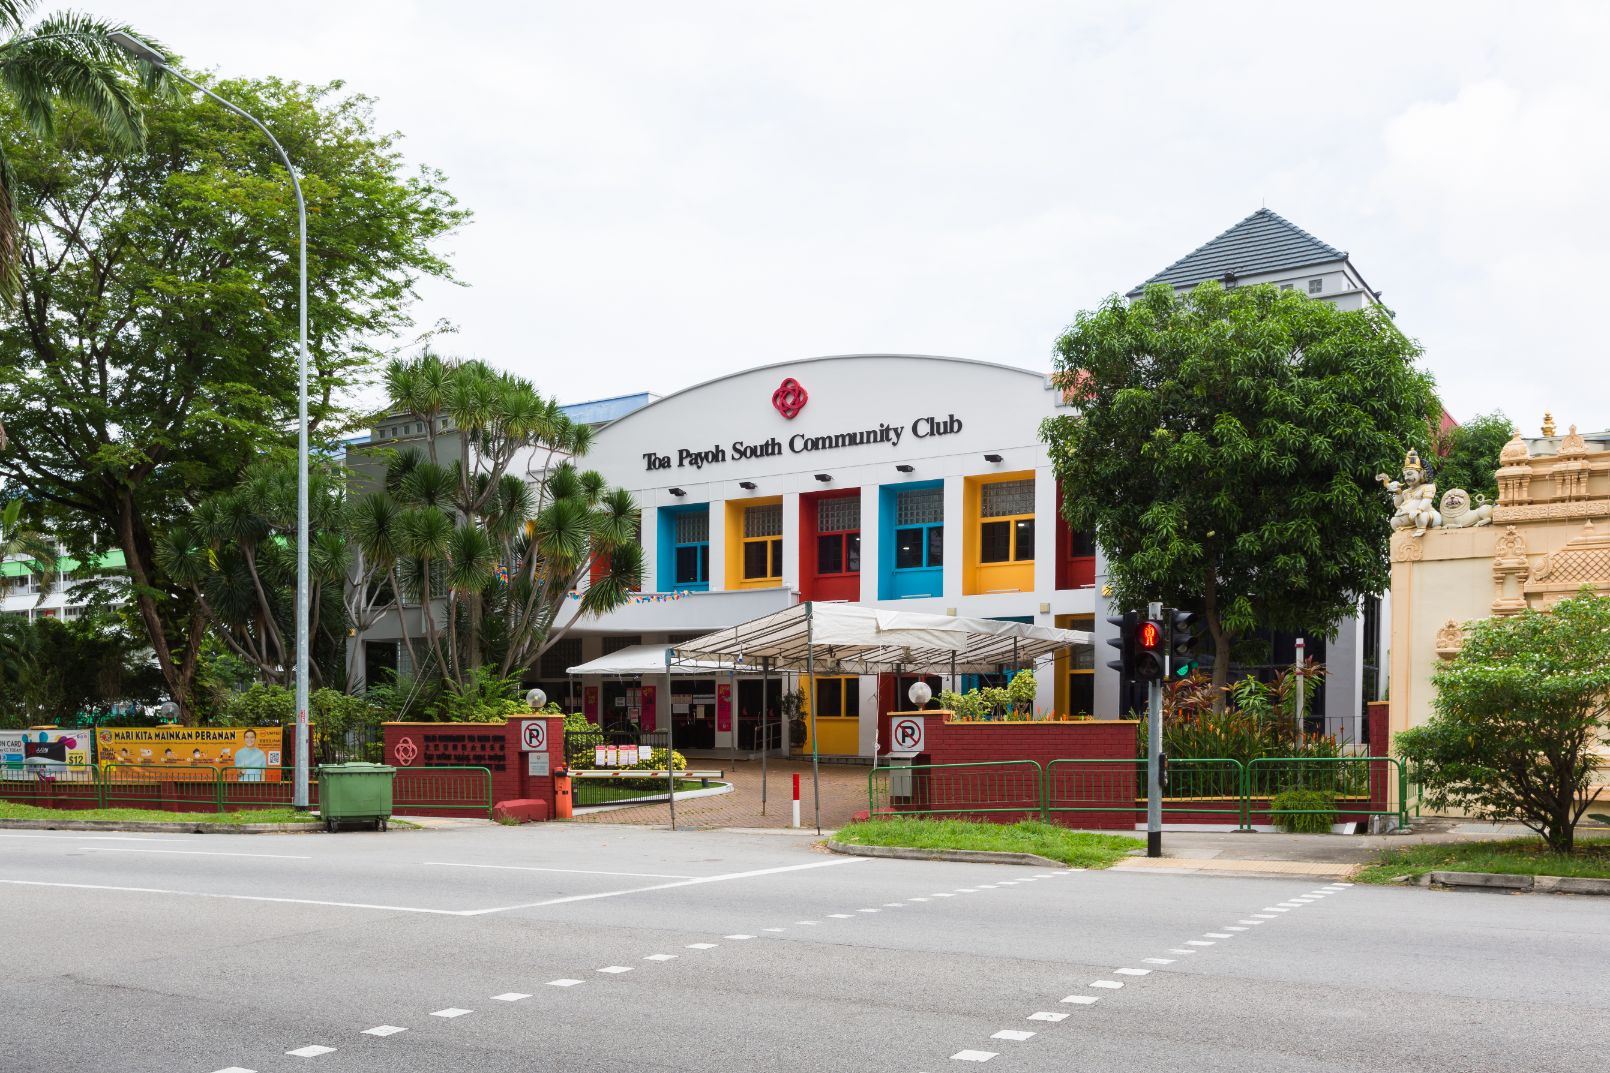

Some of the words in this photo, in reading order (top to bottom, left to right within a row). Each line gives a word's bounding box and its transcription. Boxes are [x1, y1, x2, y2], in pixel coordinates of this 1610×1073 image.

[643, 453, 671, 471] Toa
[677, 445, 726, 469] Payoh
[731, 438, 782, 461] South
[789, 423, 904, 454] Community
[912, 414, 963, 438] Club
[114, 731, 133, 740] MARI
[135, 731, 152, 740] KITA
[155, 731, 193, 740] MAINKAN
[195, 731, 236, 740] PERANAN
[68, 755, 84, 765] $12
